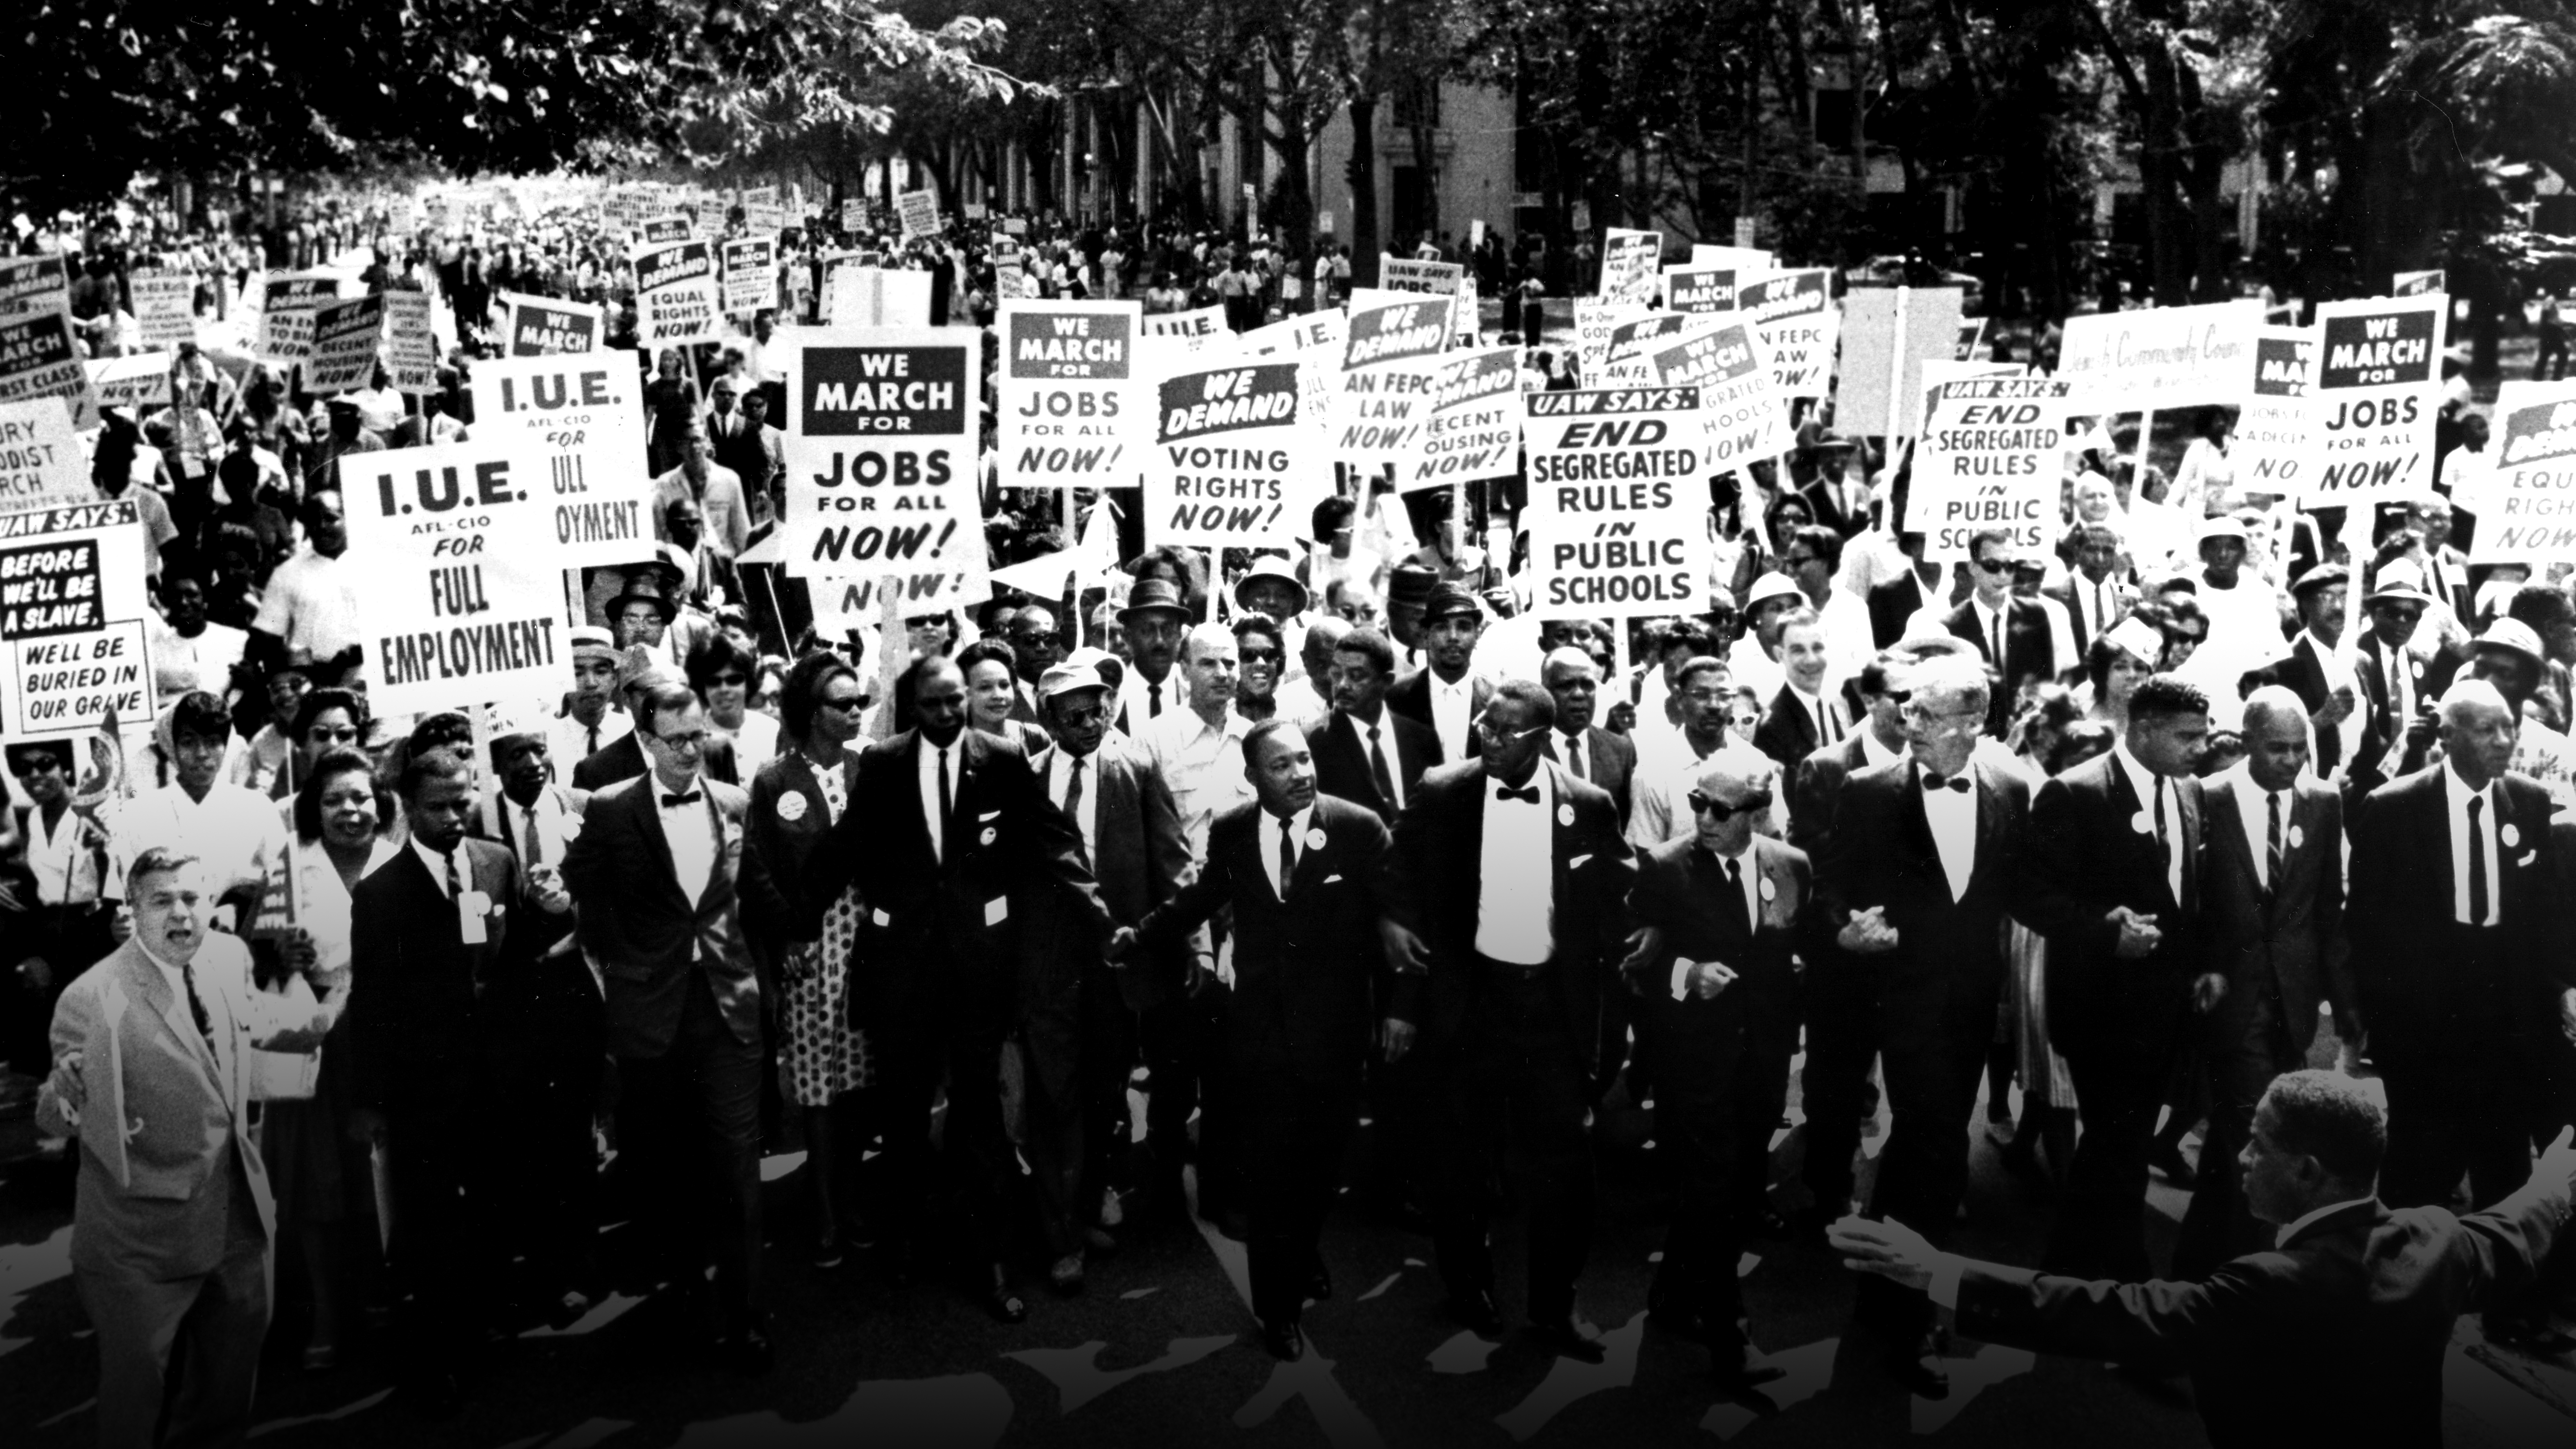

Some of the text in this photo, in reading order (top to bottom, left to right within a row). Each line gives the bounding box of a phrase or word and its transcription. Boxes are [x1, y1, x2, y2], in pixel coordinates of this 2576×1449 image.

[658, 247, 684, 267] WE
[642, 257, 707, 289] DEMAND
[1388, 264, 1419, 277] UAW
[652, 290, 706, 306] EQUAL
[1674, 286, 1733, 304] MARCH
[546, 312, 570, 330] WE
[652, 304, 710, 320] RIGHTS
[1380, 305, 1420, 332] WE
[520, 325, 587, 351] MARCH
[653, 319, 712, 338] NOW!
[1053, 318, 1089, 337] WE
[1779, 329, 1822, 344] FEPC
[2365, 318, 2399, 339] WE
[3, 333, 62, 361] ARCH
[1018, 338, 1122, 362] MARCH
[1350, 324, 1441, 364] DEMAND
[2330, 338, 2426, 369] MARCH
[860, 354, 909, 377] WE
[1665, 342, 1749, 386] MARCH
[1773, 350, 1807, 364] AW
[32, 364, 79, 387] CLASS
[1050, 364, 1091, 376] FOR
[1606, 365, 1648, 379] AN FE
[2359, 369, 2395, 383] FOR
[501, 370, 621, 412] I.U.E.
[1203, 369, 1256, 400] WE
[1345, 373, 1376, 393] AN
[1384, 372, 1433, 395] FEPC
[1706, 378, 1765, 409] GRATED
[814, 382, 953, 411] MARCH
[1018, 391, 1119, 418] JOBS
[1360, 398, 1412, 419] LAW
[1534, 388, 1696, 414] UAW SAYS:
[858, 416, 911, 430] FOR
[1166, 392, 1294, 435] DEMAND
[1427, 409, 1505, 433] ECENT
[1703, 400, 1773, 435] HOOLS
[1959, 404, 2041, 425] END
[2325, 395, 2418, 431] JOBS
[546, 429, 585, 447] FOR
[1022, 424, 1116, 435] FOR ALL
[1339, 423, 1419, 449] NOW!
[1557, 419, 1667, 448] END
[1938, 428, 2059, 452] SEGREGATED
[2327, 433, 2411, 450] FOR ALL
[1424, 430, 1512, 455] OUSING
[813, 449, 951, 487] JOBS
[1017, 443, 1123, 473] NOW!
[1168, 446, 1289, 473] VOTING
[1415, 446, 1506, 480] NOW!
[1533, 448, 1696, 483] SEGREGATED
[1954, 454, 2037, 476] RULES
[552, 454, 588, 495] ULL
[2319, 452, 2419, 491] NOW!
[2512, 470, 2574, 489] EQU
[378, 460, 528, 517] I.U.E.
[1175, 475, 1282, 501] RIGHTS
[1558, 482, 1673, 513] RULES
[1978, 485, 2008, 496] IN
[819, 495, 946, 511] FOR ALL
[1946, 499, 2041, 522] PUBLIC
[2504, 497, 2576, 516] RIGH
[52, 503, 132, 531] SAYS:
[411, 515, 490, 535] AFL-CIO
[555, 500, 639, 544] OYMENT
[1170, 502, 1283, 533] NOW!
[1594, 521, 1637, 538] IN
[433, 534, 485, 557] FOR
[812, 518, 957, 562] NOW!
[1939, 526, 2042, 550] SCLS
[2496, 526, 2576, 549] NOW
[1, 547, 90, 578] BEFORE
[1554, 538, 1685, 570] PUBLIC
[4, 574, 95, 605] WE'LL BE
[429, 564, 489, 617] FULL
[1548, 572, 1691, 606] SCHOOLS
[4, 601, 99, 633] A SLAVE,
[93, 637, 125, 659] BE
[380, 617, 554, 685] EMPLOYMENT
[26, 664, 138, 693] BURIED IN
[30, 698, 68, 720] OUR
